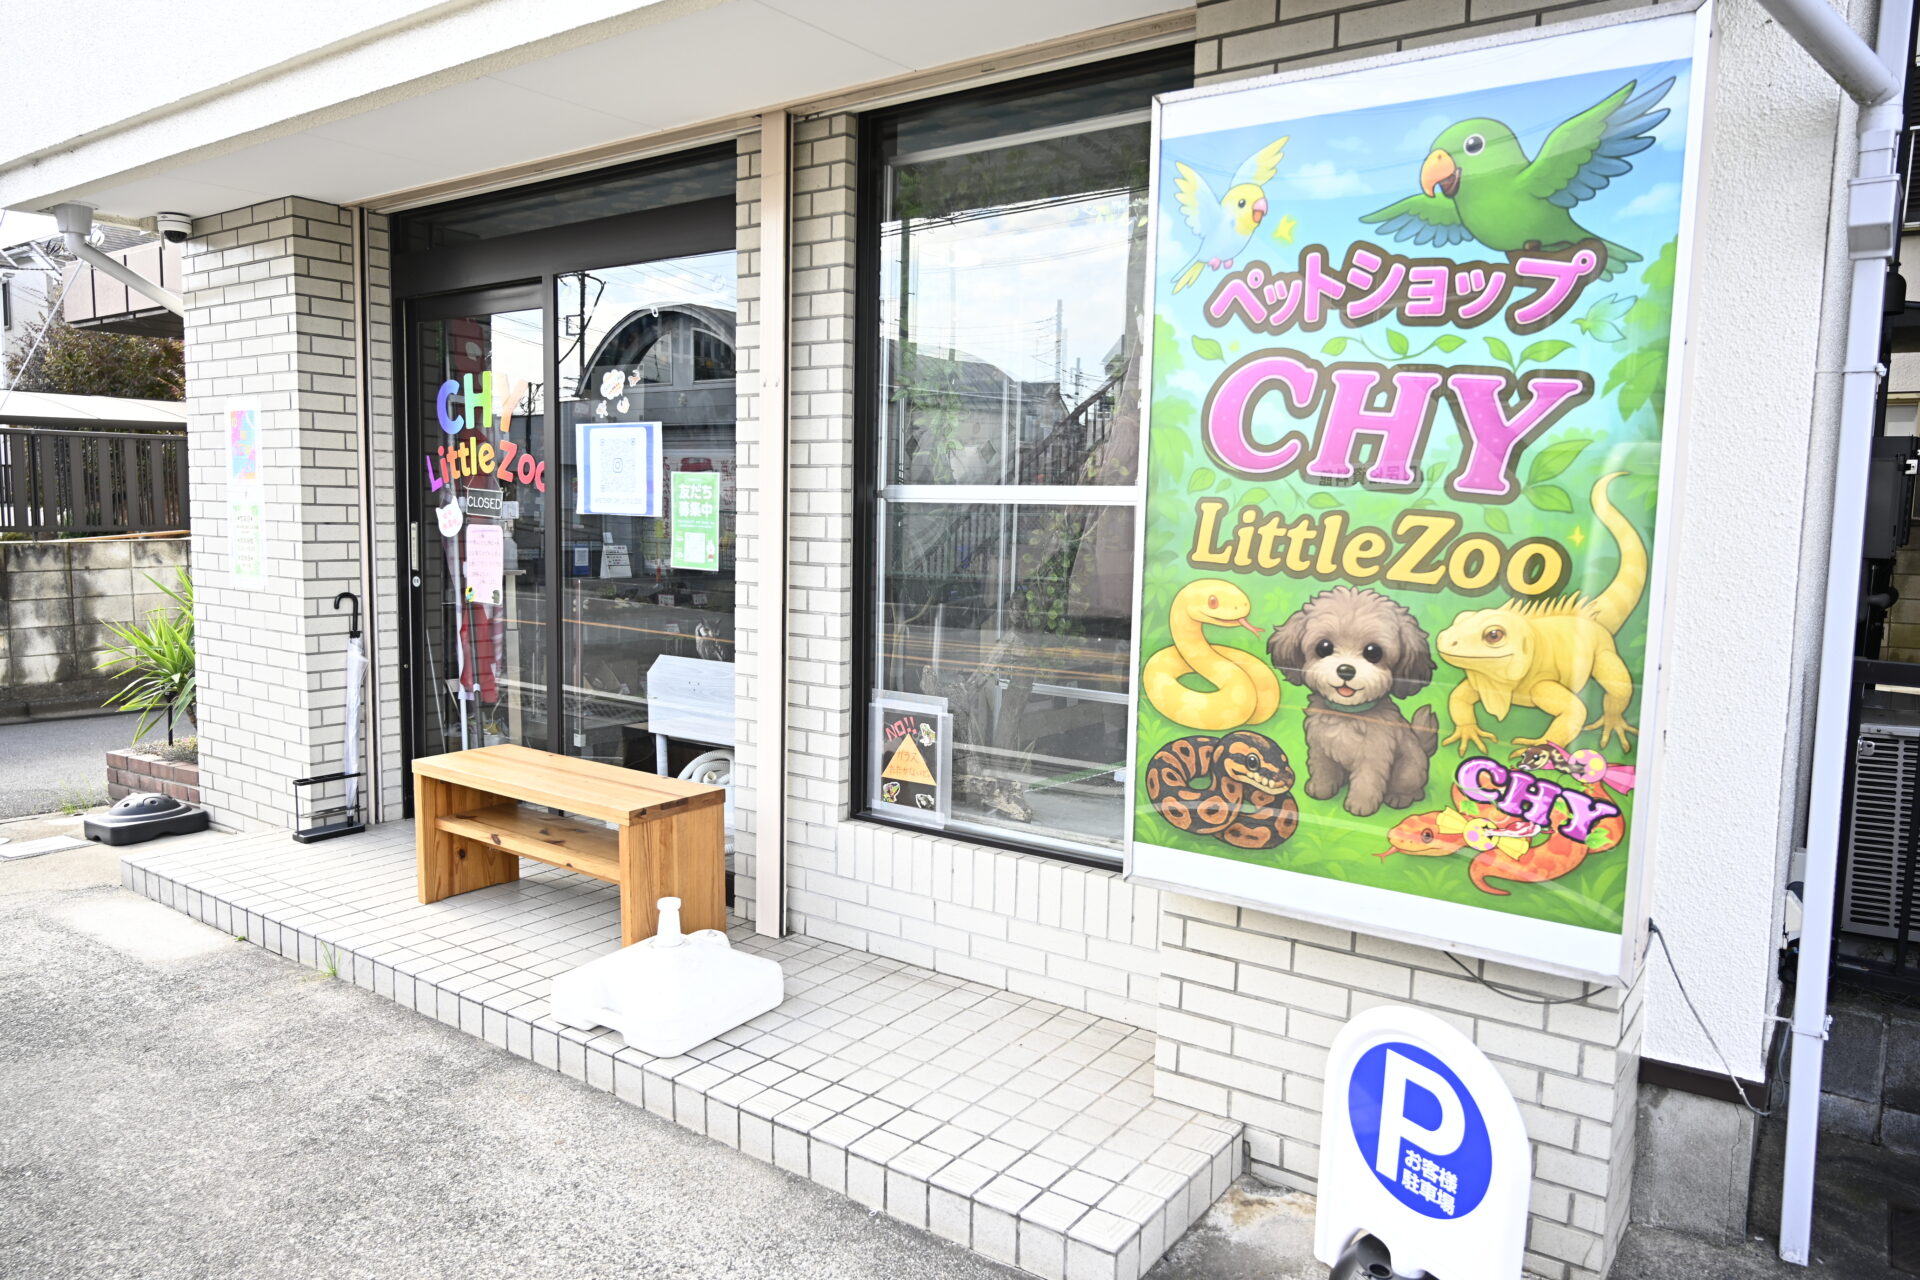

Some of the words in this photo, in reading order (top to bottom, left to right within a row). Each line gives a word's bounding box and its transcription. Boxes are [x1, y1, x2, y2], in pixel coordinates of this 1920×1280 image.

[1208, 247, 1598, 328] ペットショップ
[436, 371, 529, 435] CHY
[1207, 355, 1585, 497] CHY
[426, 437, 496, 492] Little
[467, 496, 502, 509] CLOSED
[678, 483, 713, 499] 友だち
[678, 500, 713, 518] 募集中
[885, 716, 918, 741] NO!!
[1456, 757, 1620, 842] CHY
[1402, 1168, 1456, 1216] 駐車場
[1404, 1149, 1458, 1194] お客様
